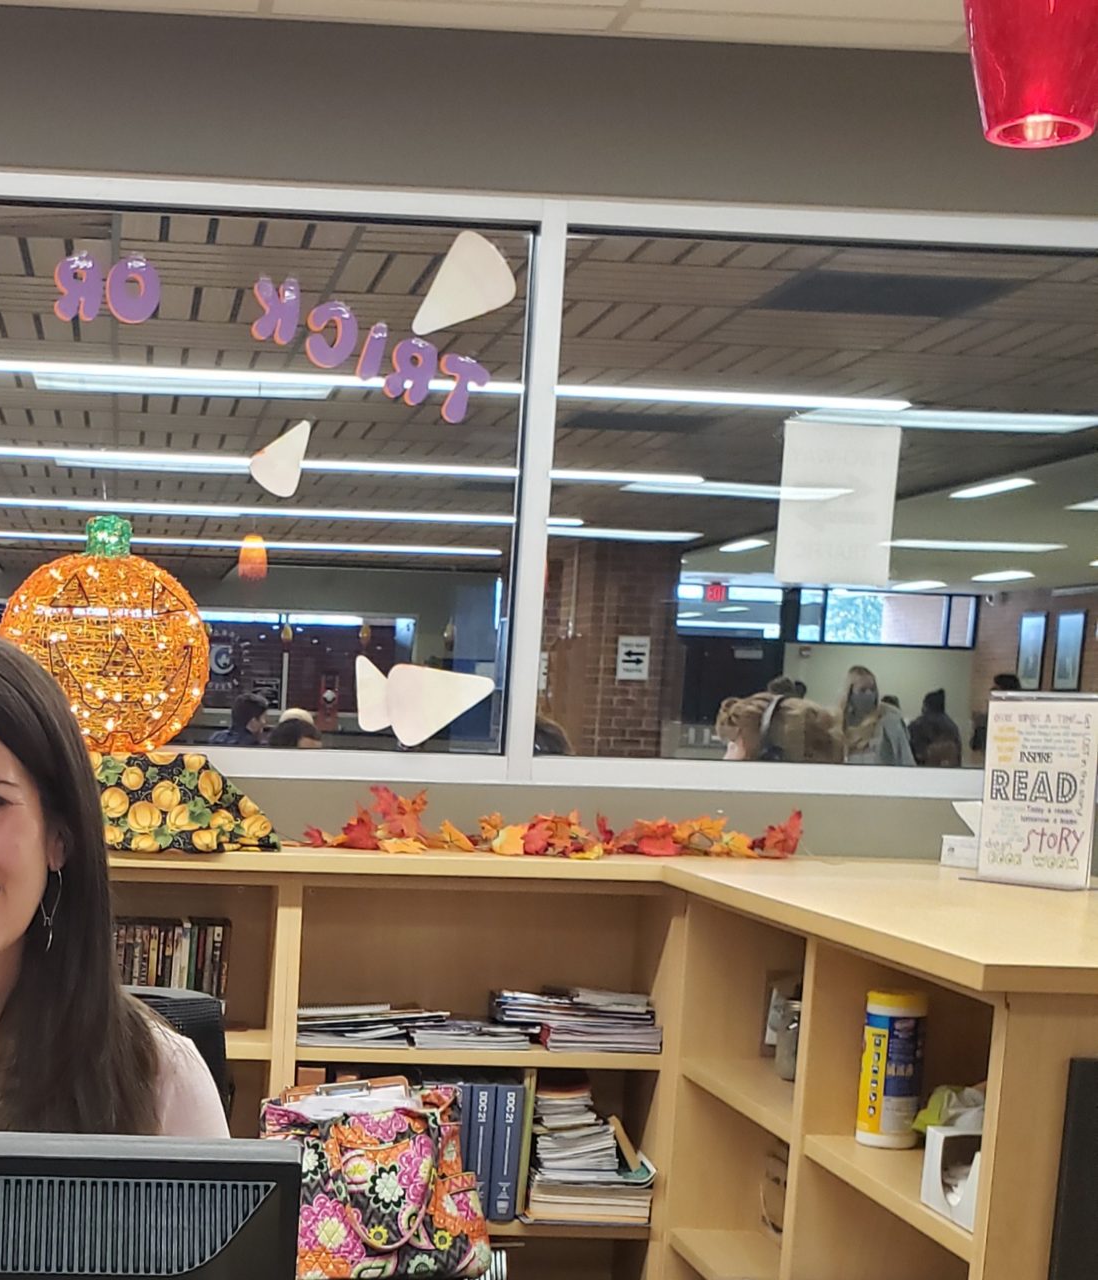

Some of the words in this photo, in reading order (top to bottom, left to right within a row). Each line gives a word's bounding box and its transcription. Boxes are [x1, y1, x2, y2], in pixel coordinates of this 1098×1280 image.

[990, 769, 1078, 803] READ
[478, 1091, 488, 1112] DDC
[506, 1091, 516, 1112] DDC
[477, 1112, 487, 1123] 21
[505, 1113, 514, 1123] 21
